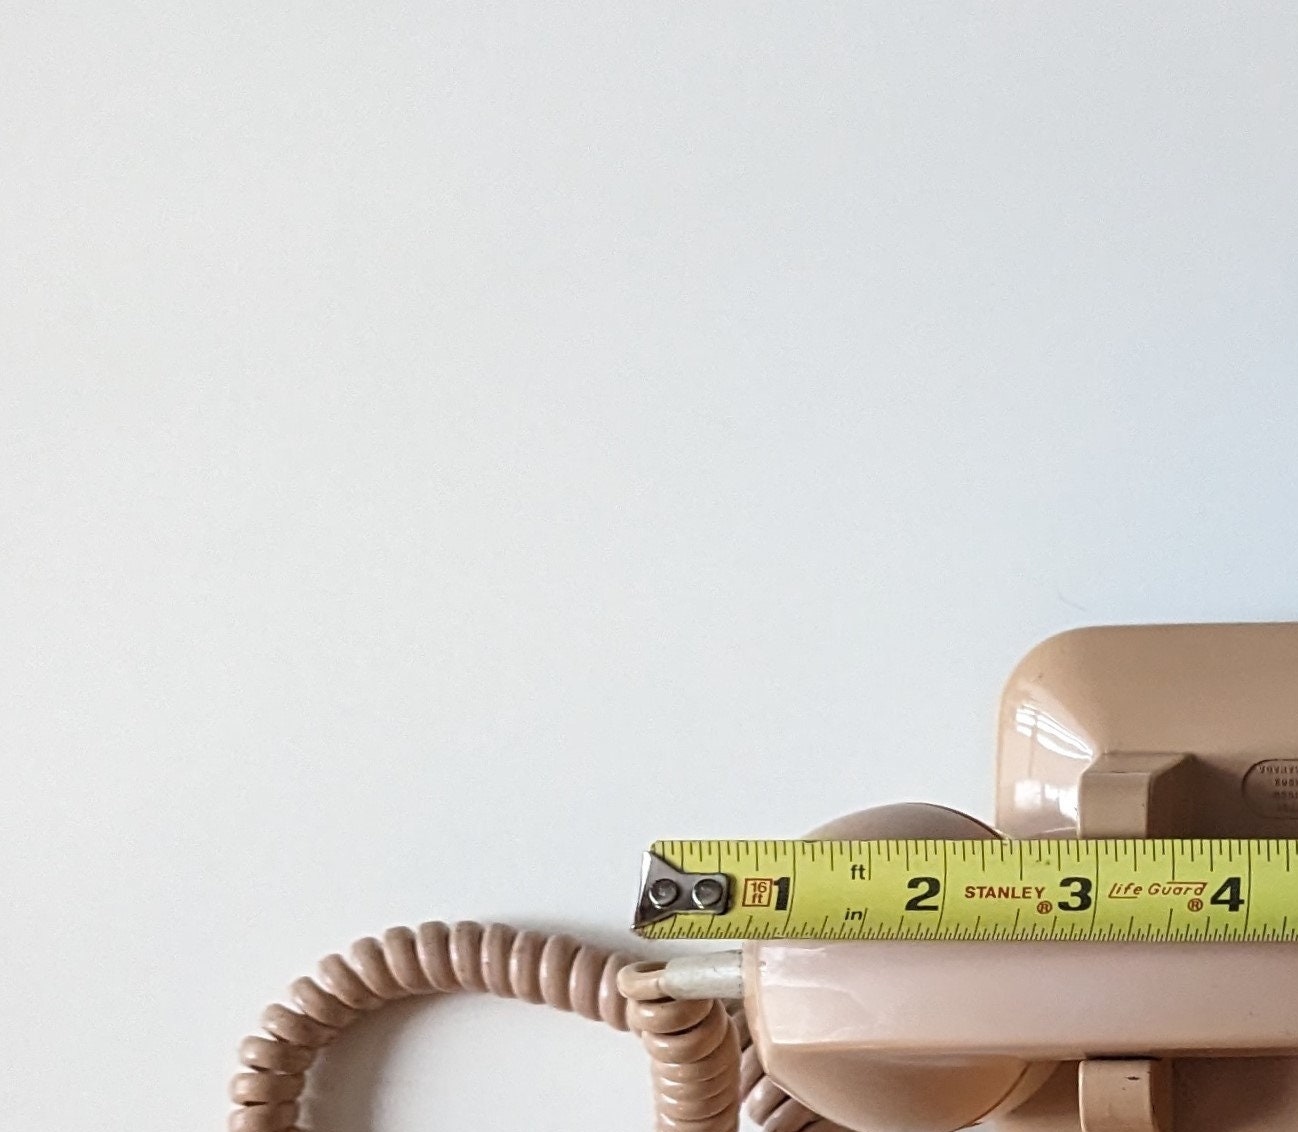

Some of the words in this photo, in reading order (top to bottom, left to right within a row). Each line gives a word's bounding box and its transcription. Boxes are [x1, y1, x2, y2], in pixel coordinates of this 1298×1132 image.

[850, 864, 866, 880] ft
[751, 881, 767, 893] 16
[773, 876, 791, 911] 1
[905, 876, 942, 912] 2
[964, 884, 1046, 900] STANLEY
[1058, 876, 1093, 912] 3
[1108, 882, 1143, 899] Life
[1148, 881, 1208, 896] Guard
[1210, 876, 1245, 912] 4
[751, 893, 764, 904] ft
[844, 908, 863, 920] in
